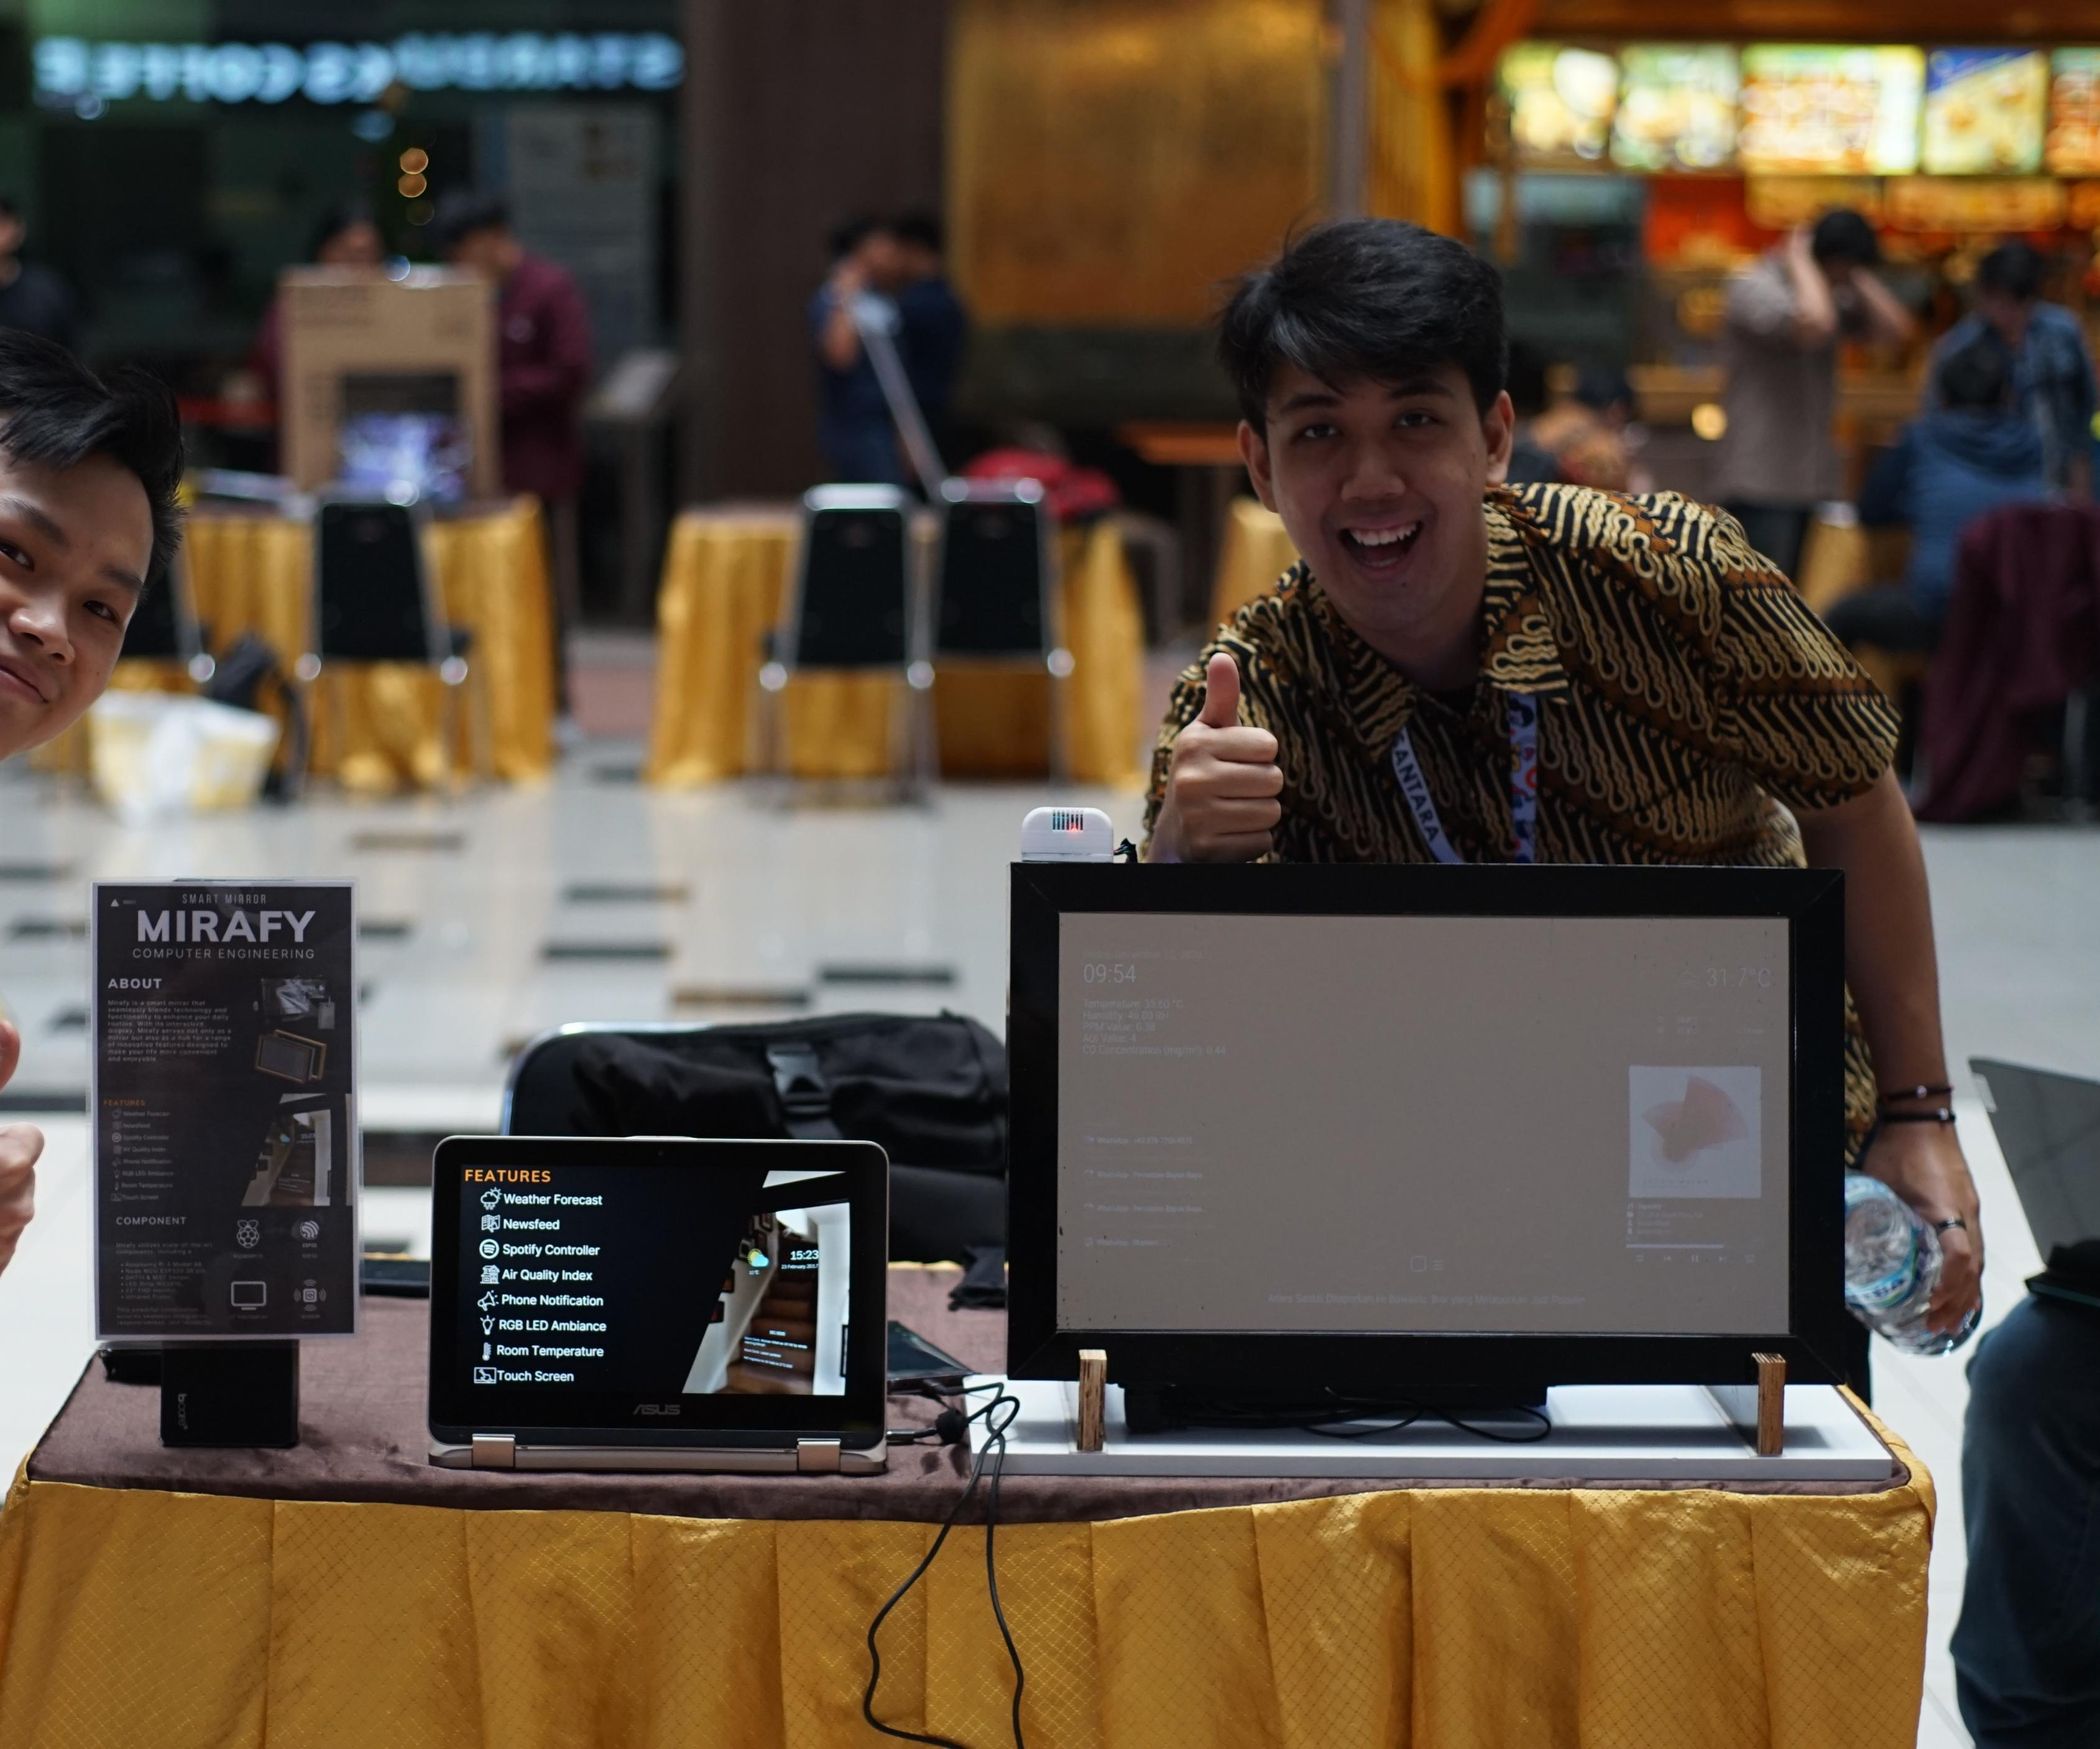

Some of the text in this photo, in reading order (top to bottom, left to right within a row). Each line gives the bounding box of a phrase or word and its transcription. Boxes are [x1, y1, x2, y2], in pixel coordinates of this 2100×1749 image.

[182, 894, 267, 904] SMART MIRROR
[137, 910, 316, 943] MIRAFY
[132, 948, 316, 959] COMPUTER ENGINEERING
[1083, 963, 1137, 984] 09:54
[107, 978, 162, 989] ABOUT
[103, 1099, 146, 1107] FEATURES
[464, 1169, 551, 1183] FEATURES
[503, 1194, 603, 1206] Weather Forecast
[115, 1216, 187, 1226] COMPONENT
[503, 1219, 561, 1230] Newsfeed
[502, 1244, 601, 1257] Spotify Controller
[790, 1249, 819, 1261] 15:23
[502, 1269, 593, 1283] Air Quality Index
[501, 1294, 604, 1306] Phone Notification
[499, 1320, 607, 1332] RGB LED Ambiance
[497, 1345, 604, 1358] Room Temperature
[497, 1370, 575, 1382] Touch Screen
[633, 1404, 681, 1416] ASUS
